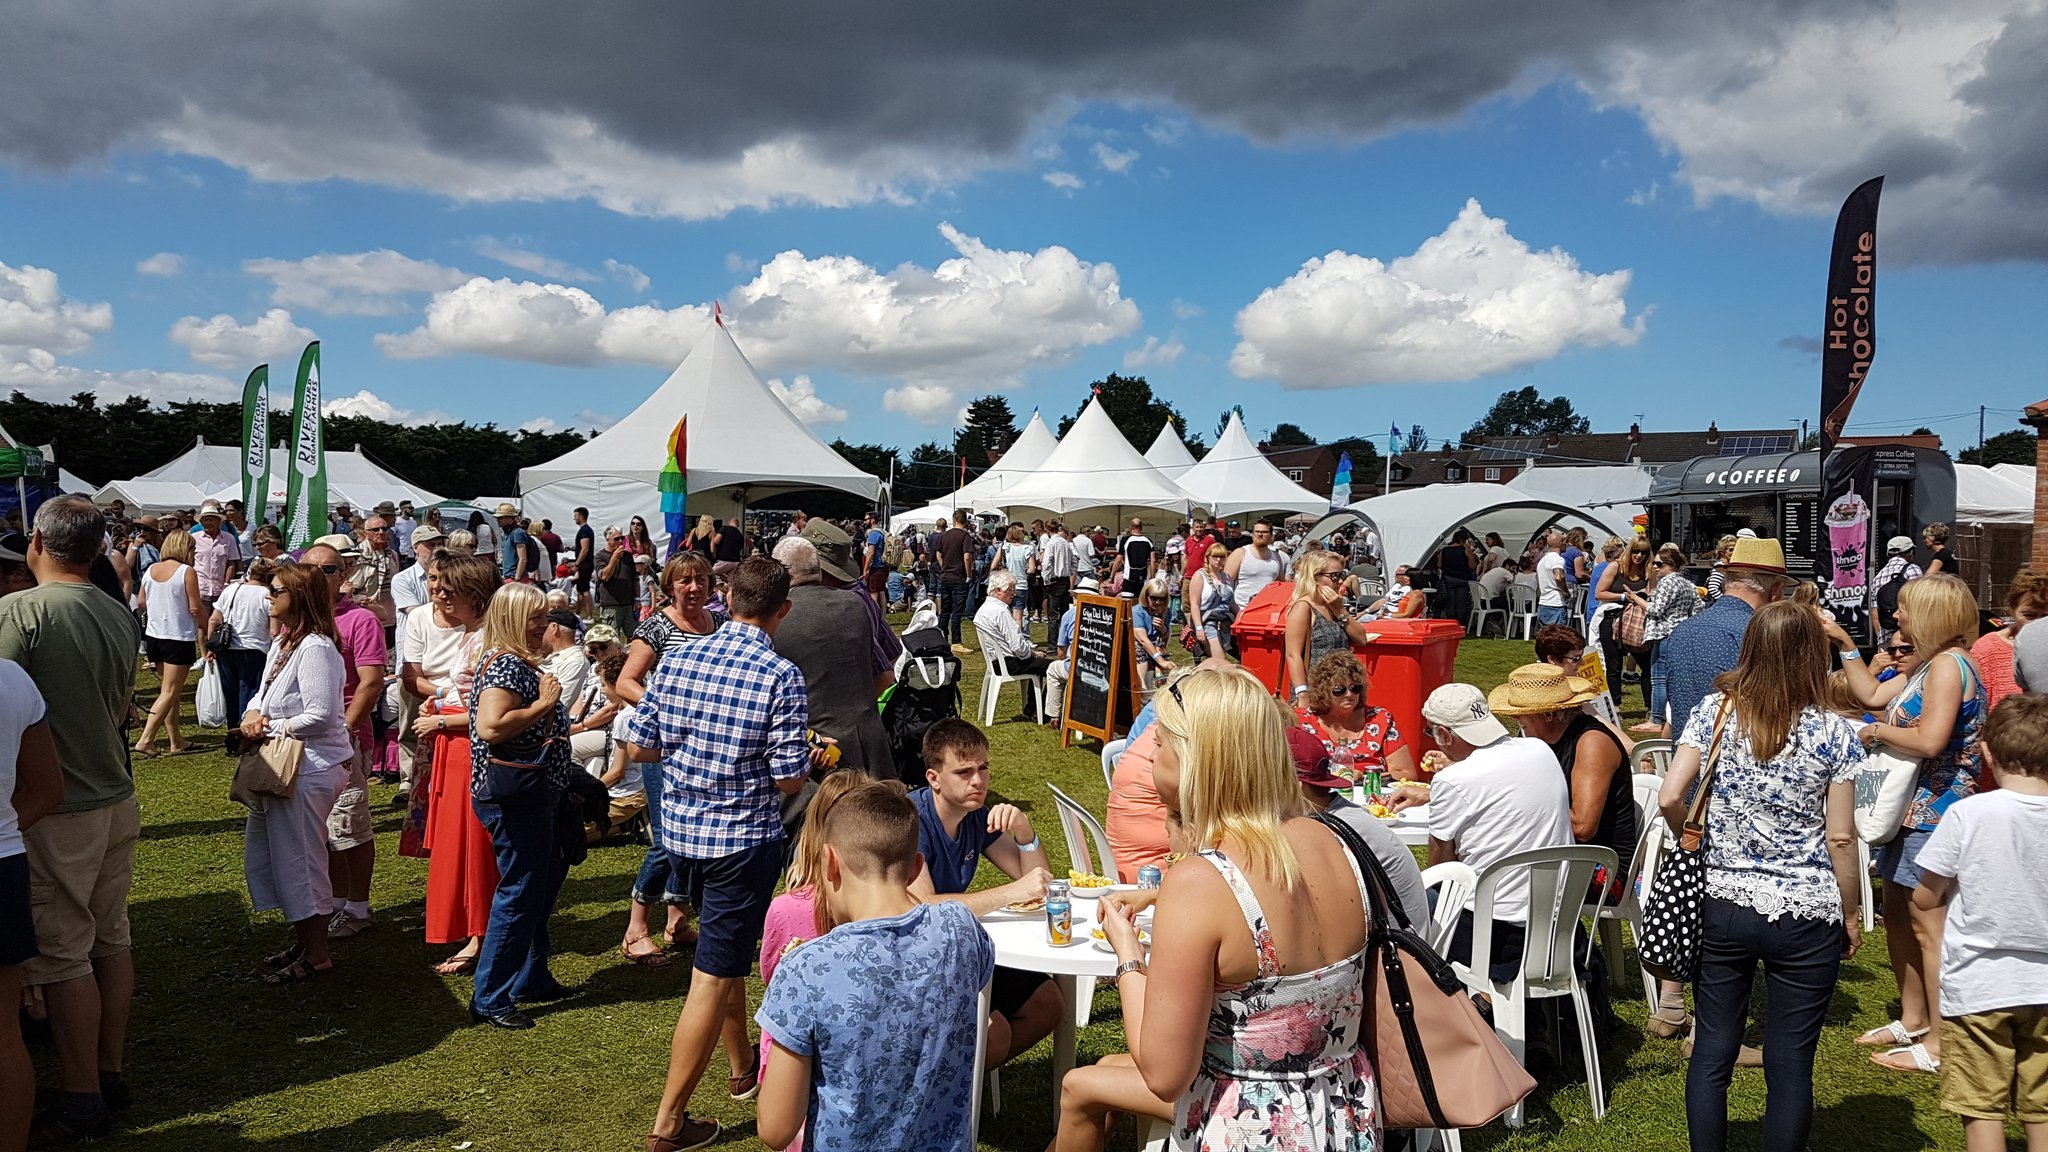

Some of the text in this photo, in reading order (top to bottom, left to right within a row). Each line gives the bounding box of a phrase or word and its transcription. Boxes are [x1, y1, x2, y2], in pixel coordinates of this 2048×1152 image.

[1829, 296, 1848, 350] Hot
[310, 380, 318, 424] FARMERS
[298, 378, 312, 464] RIVERFORD
[1874, 450, 1915, 459] xpress Coffee
[1718, 468, 1788, 485] COFFEE
[1824, 585, 1867, 600] shmoo
[1577, 665, 1596, 678] ACKET
[1470, 702, 1485, 720] NY
